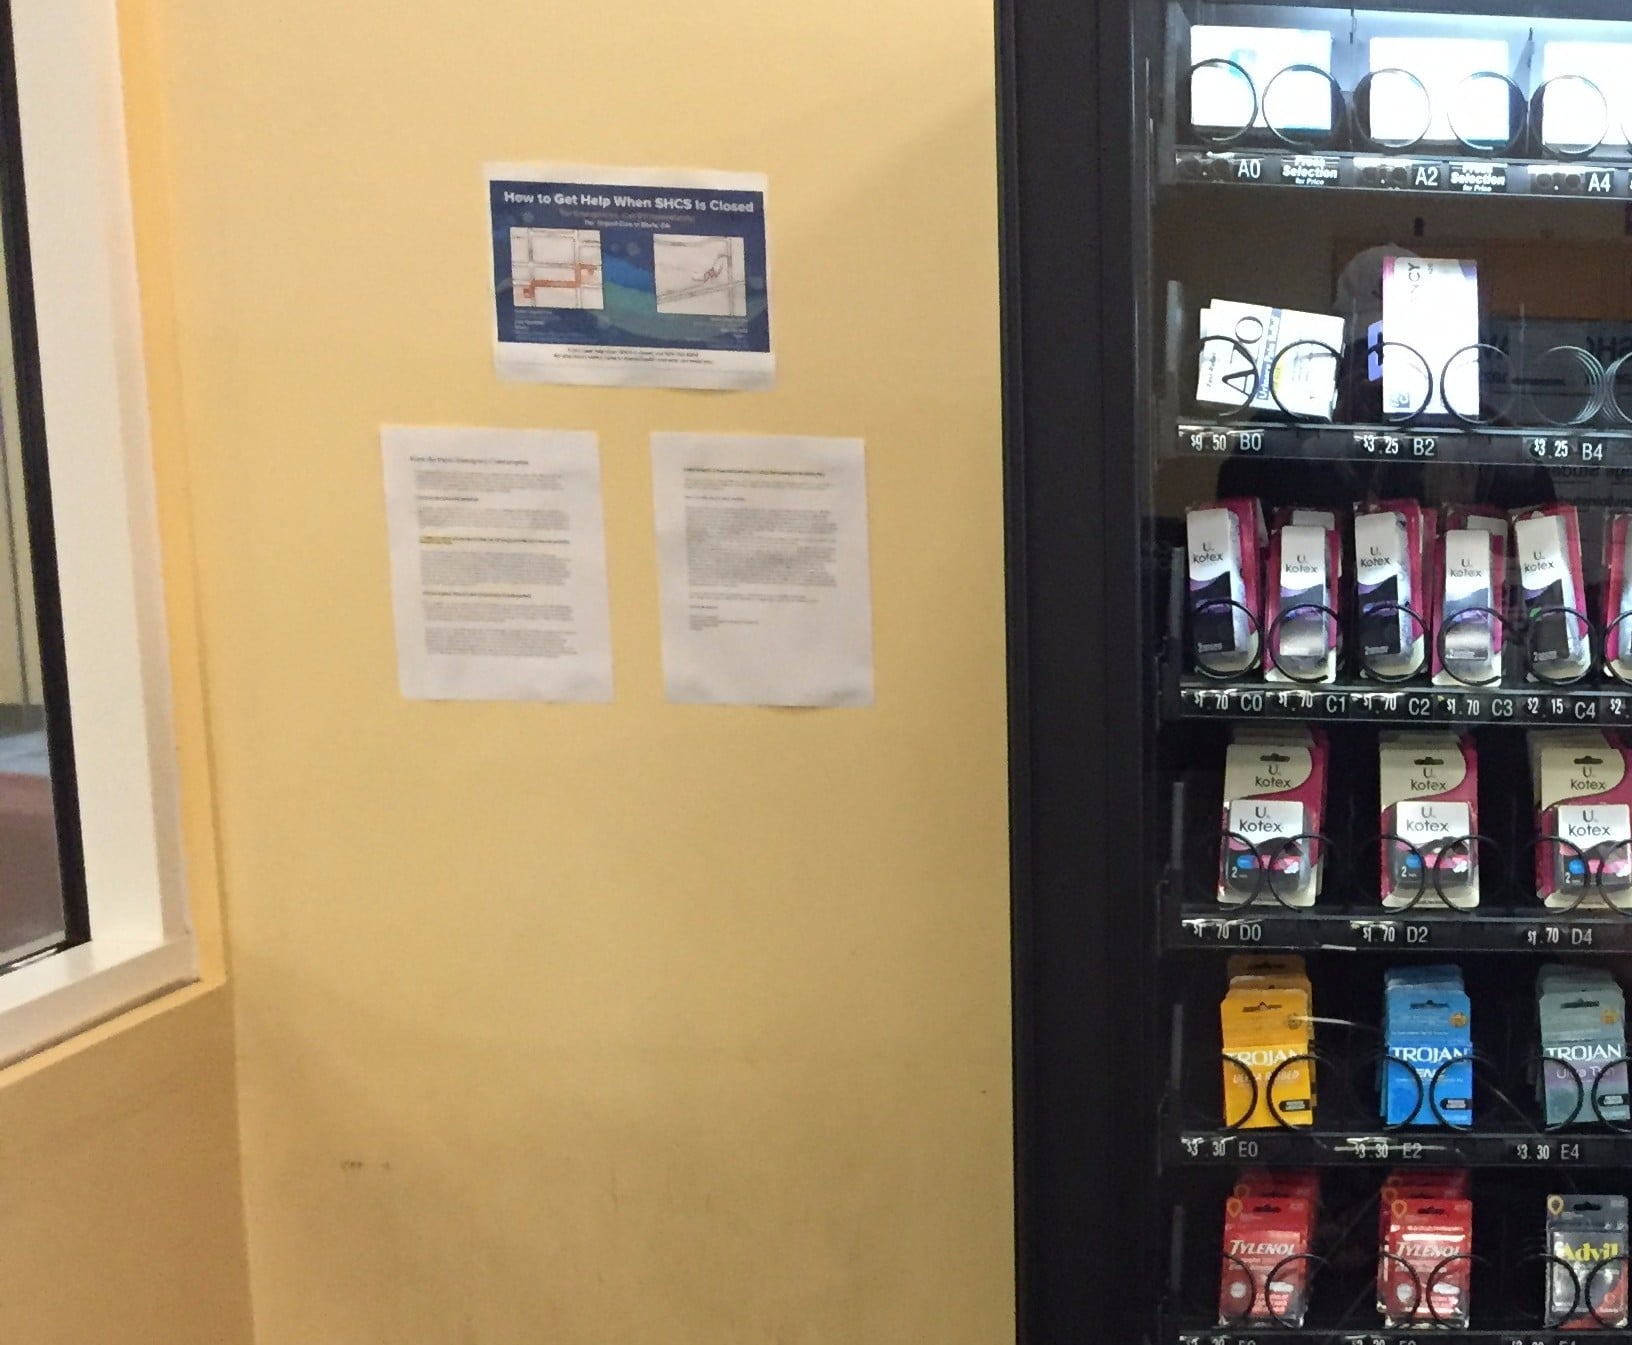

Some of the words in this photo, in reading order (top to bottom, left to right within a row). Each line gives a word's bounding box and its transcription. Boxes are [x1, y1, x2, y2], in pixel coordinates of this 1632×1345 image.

[1237, 159, 1260, 178] A0
[1283, 165, 1337, 178] Selection
[1415, 167, 1438, 186] A2
[1451, 172, 1505, 185] Selection
[1588, 172, 1610, 192] A4
[503, 191, 534, 203] How
[537, 194, 551, 204] to
[554, 194, 578, 206] Get
[580, 195, 610, 208] Help
[613, 195, 651, 208] When
[654, 197, 692, 210] SHCS
[710, 200, 754, 213] Closed
[1240, 433, 1261, 451] B0
[1413, 439, 1435, 456] B2
[1582, 443, 1603, 461] B4
[1193, 551, 1224, 563] kotex
[1360, 555, 1391, 567] kotex
[1285, 563, 1318, 574] kotex
[1450, 567, 1482, 578] kotex
[1524, 560, 1555, 572] kotex
[1241, 695, 1262, 712] C0
[1326, 696, 1346, 713] C1
[1408, 698, 1430, 715] C2
[1492, 699, 1513, 716] C3
[1575, 701, 1596, 719] C4
[1255, 776, 1291, 789] kotex
[1410, 779, 1447, 791] kotex
[1570, 778, 1606, 791] kotex
[1239, 819, 1283, 832] kotex
[1406, 819, 1449, 832] kotex
[1568, 823, 1611, 836] kotex
[1240, 924, 1261, 941] D0
[1407, 926, 1428, 943] D2
[1571, 928, 1592, 945] D4
[1545, 1044, 1622, 1061] TROJAN
[1239, 1142, 1258, 1157] E0
[1402, 1143, 1422, 1159] E2
[1561, 1144, 1579, 1160] E4
[1230, 1239, 1296, 1256] TYLENOL
[1395, 1241, 1460, 1258] TYLENOL
[1562, 1243, 1619, 1262] Advil
